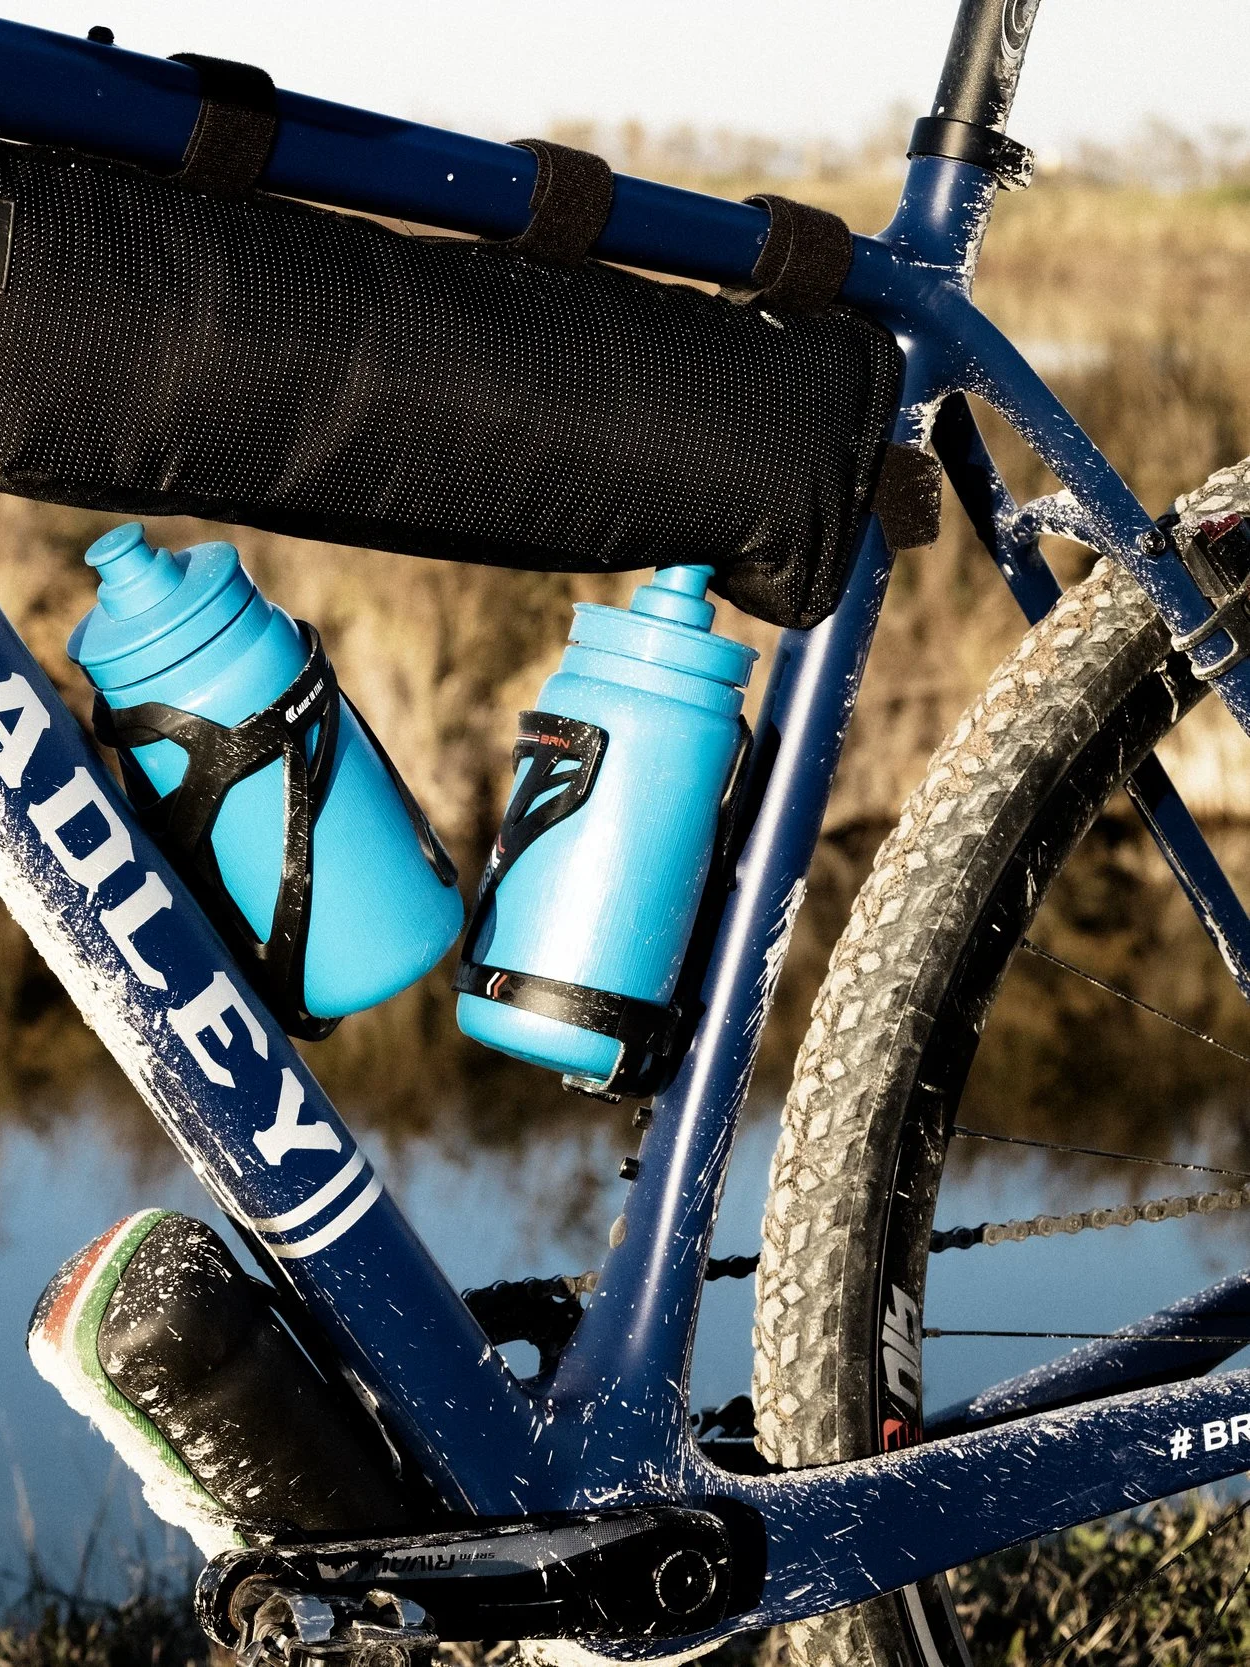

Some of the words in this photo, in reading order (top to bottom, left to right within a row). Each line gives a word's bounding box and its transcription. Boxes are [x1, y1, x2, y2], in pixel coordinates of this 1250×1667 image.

[296, 695, 312, 716] MADE
[540, 734, 571, 749] BRN
[382, 1554, 456, 1574] RIVAL
